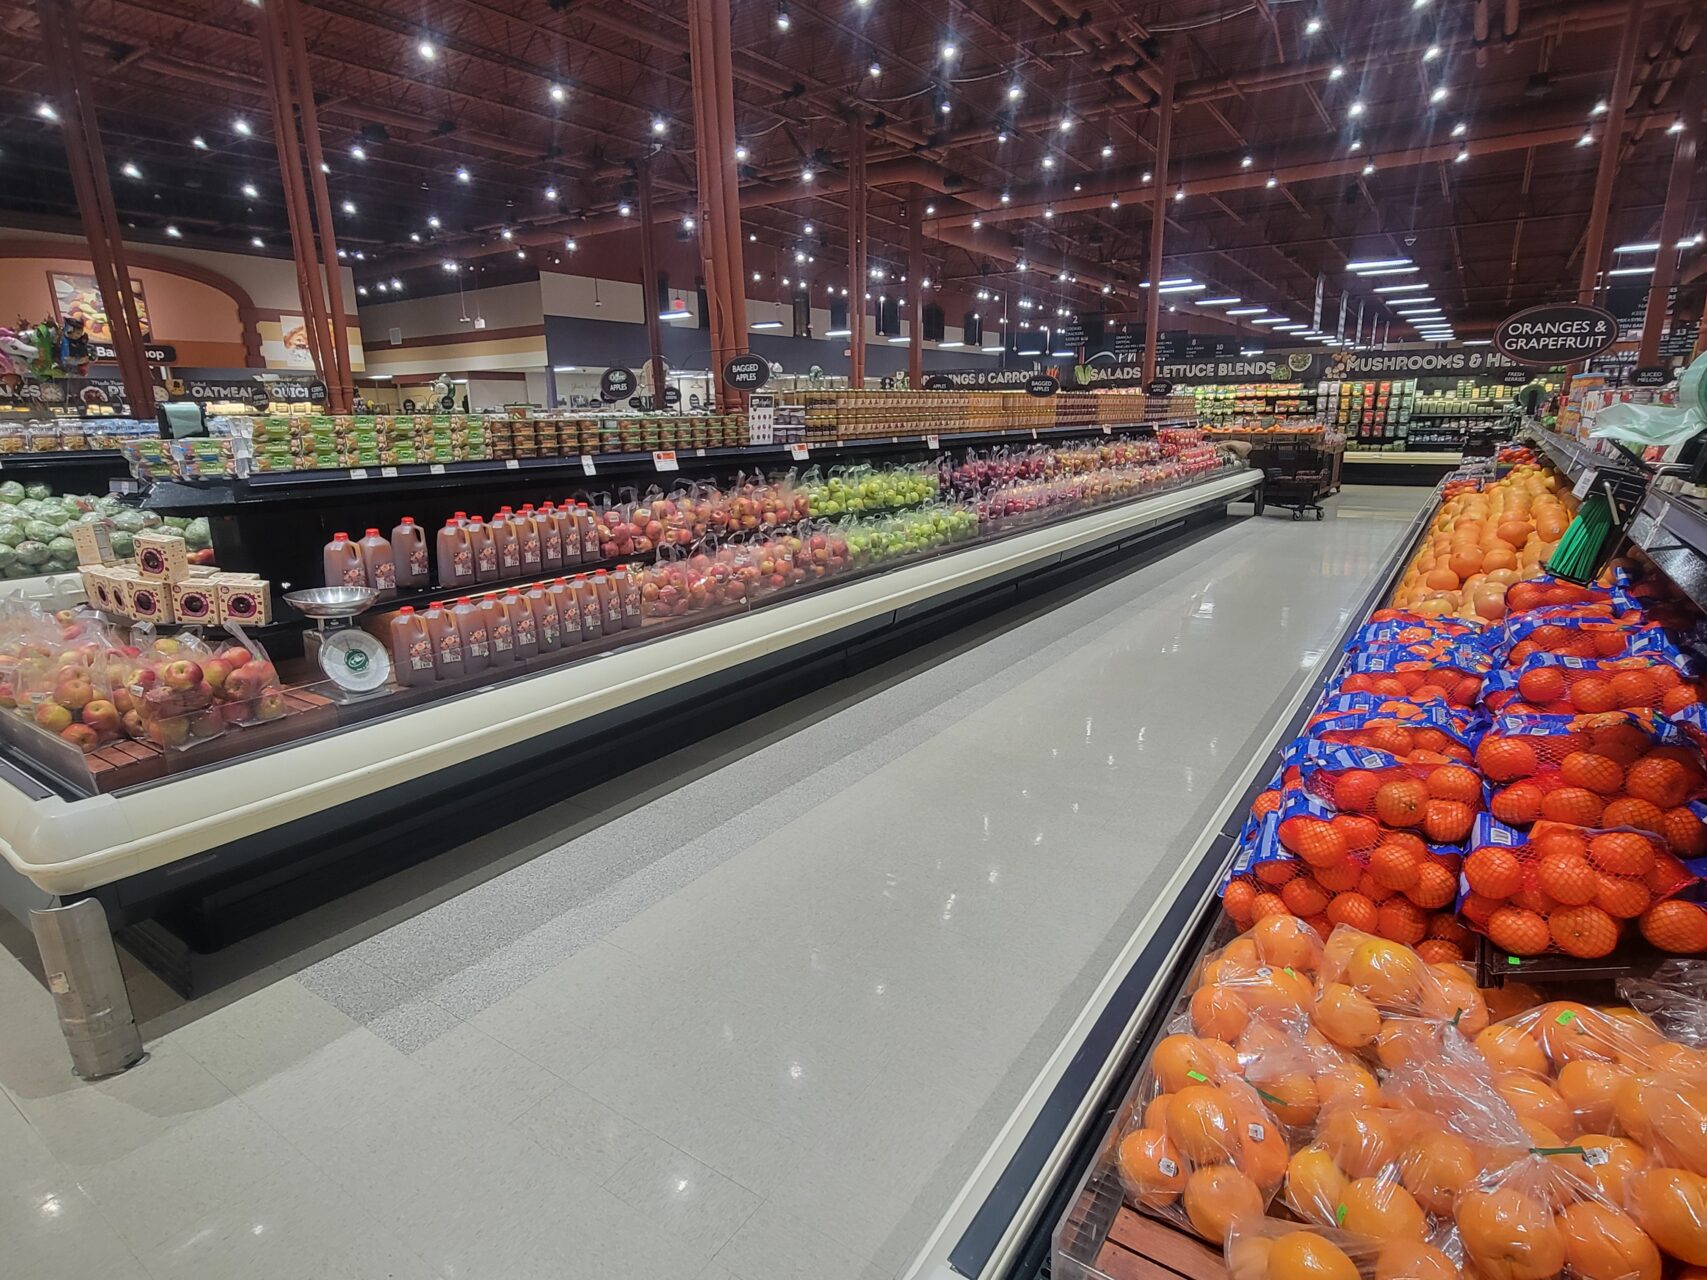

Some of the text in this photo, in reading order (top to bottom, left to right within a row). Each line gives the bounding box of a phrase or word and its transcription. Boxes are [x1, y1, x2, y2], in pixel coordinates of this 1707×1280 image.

[1072, 315, 1078, 324] 2
[1121, 325, 1127, 333] 4
[1507, 320, 1607, 336] ORANGES &
[1504, 335, 1607, 350] GRAPEFRUIT
[732, 363, 759, 373] BAGGED
[1347, 354, 1465, 372] MUSHROOMS
[1468, 353, 1482, 367] &
[1090, 366, 1142, 380] SALADS
[1156, 361, 1277, 378] LETTUCE BLENDS
[735, 372, 757, 382] APPLES
[610, 383, 628, 392] APPLES
